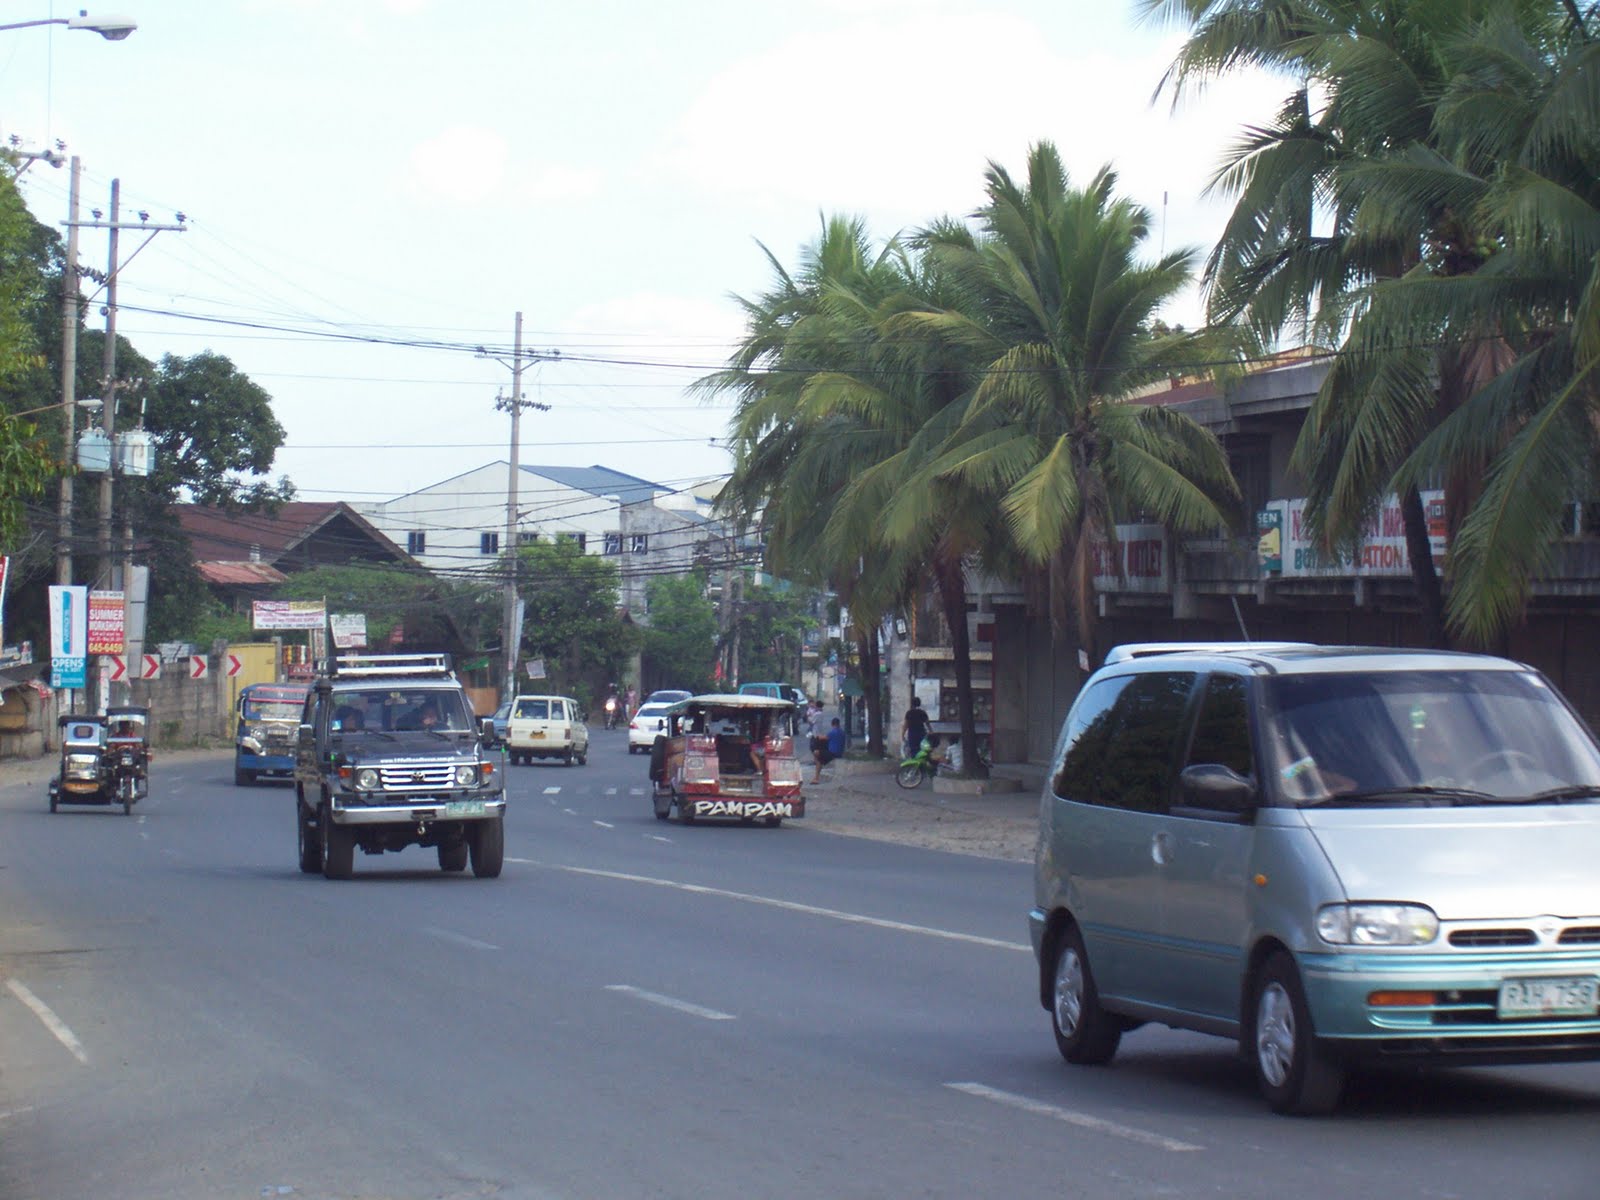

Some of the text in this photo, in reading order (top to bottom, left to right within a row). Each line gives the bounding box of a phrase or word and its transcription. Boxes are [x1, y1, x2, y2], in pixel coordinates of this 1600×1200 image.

[89, 609, 124, 620] SUMMER
[52, 659, 84, 668] OPENS
[694, 801, 792, 817] PAMPAM
